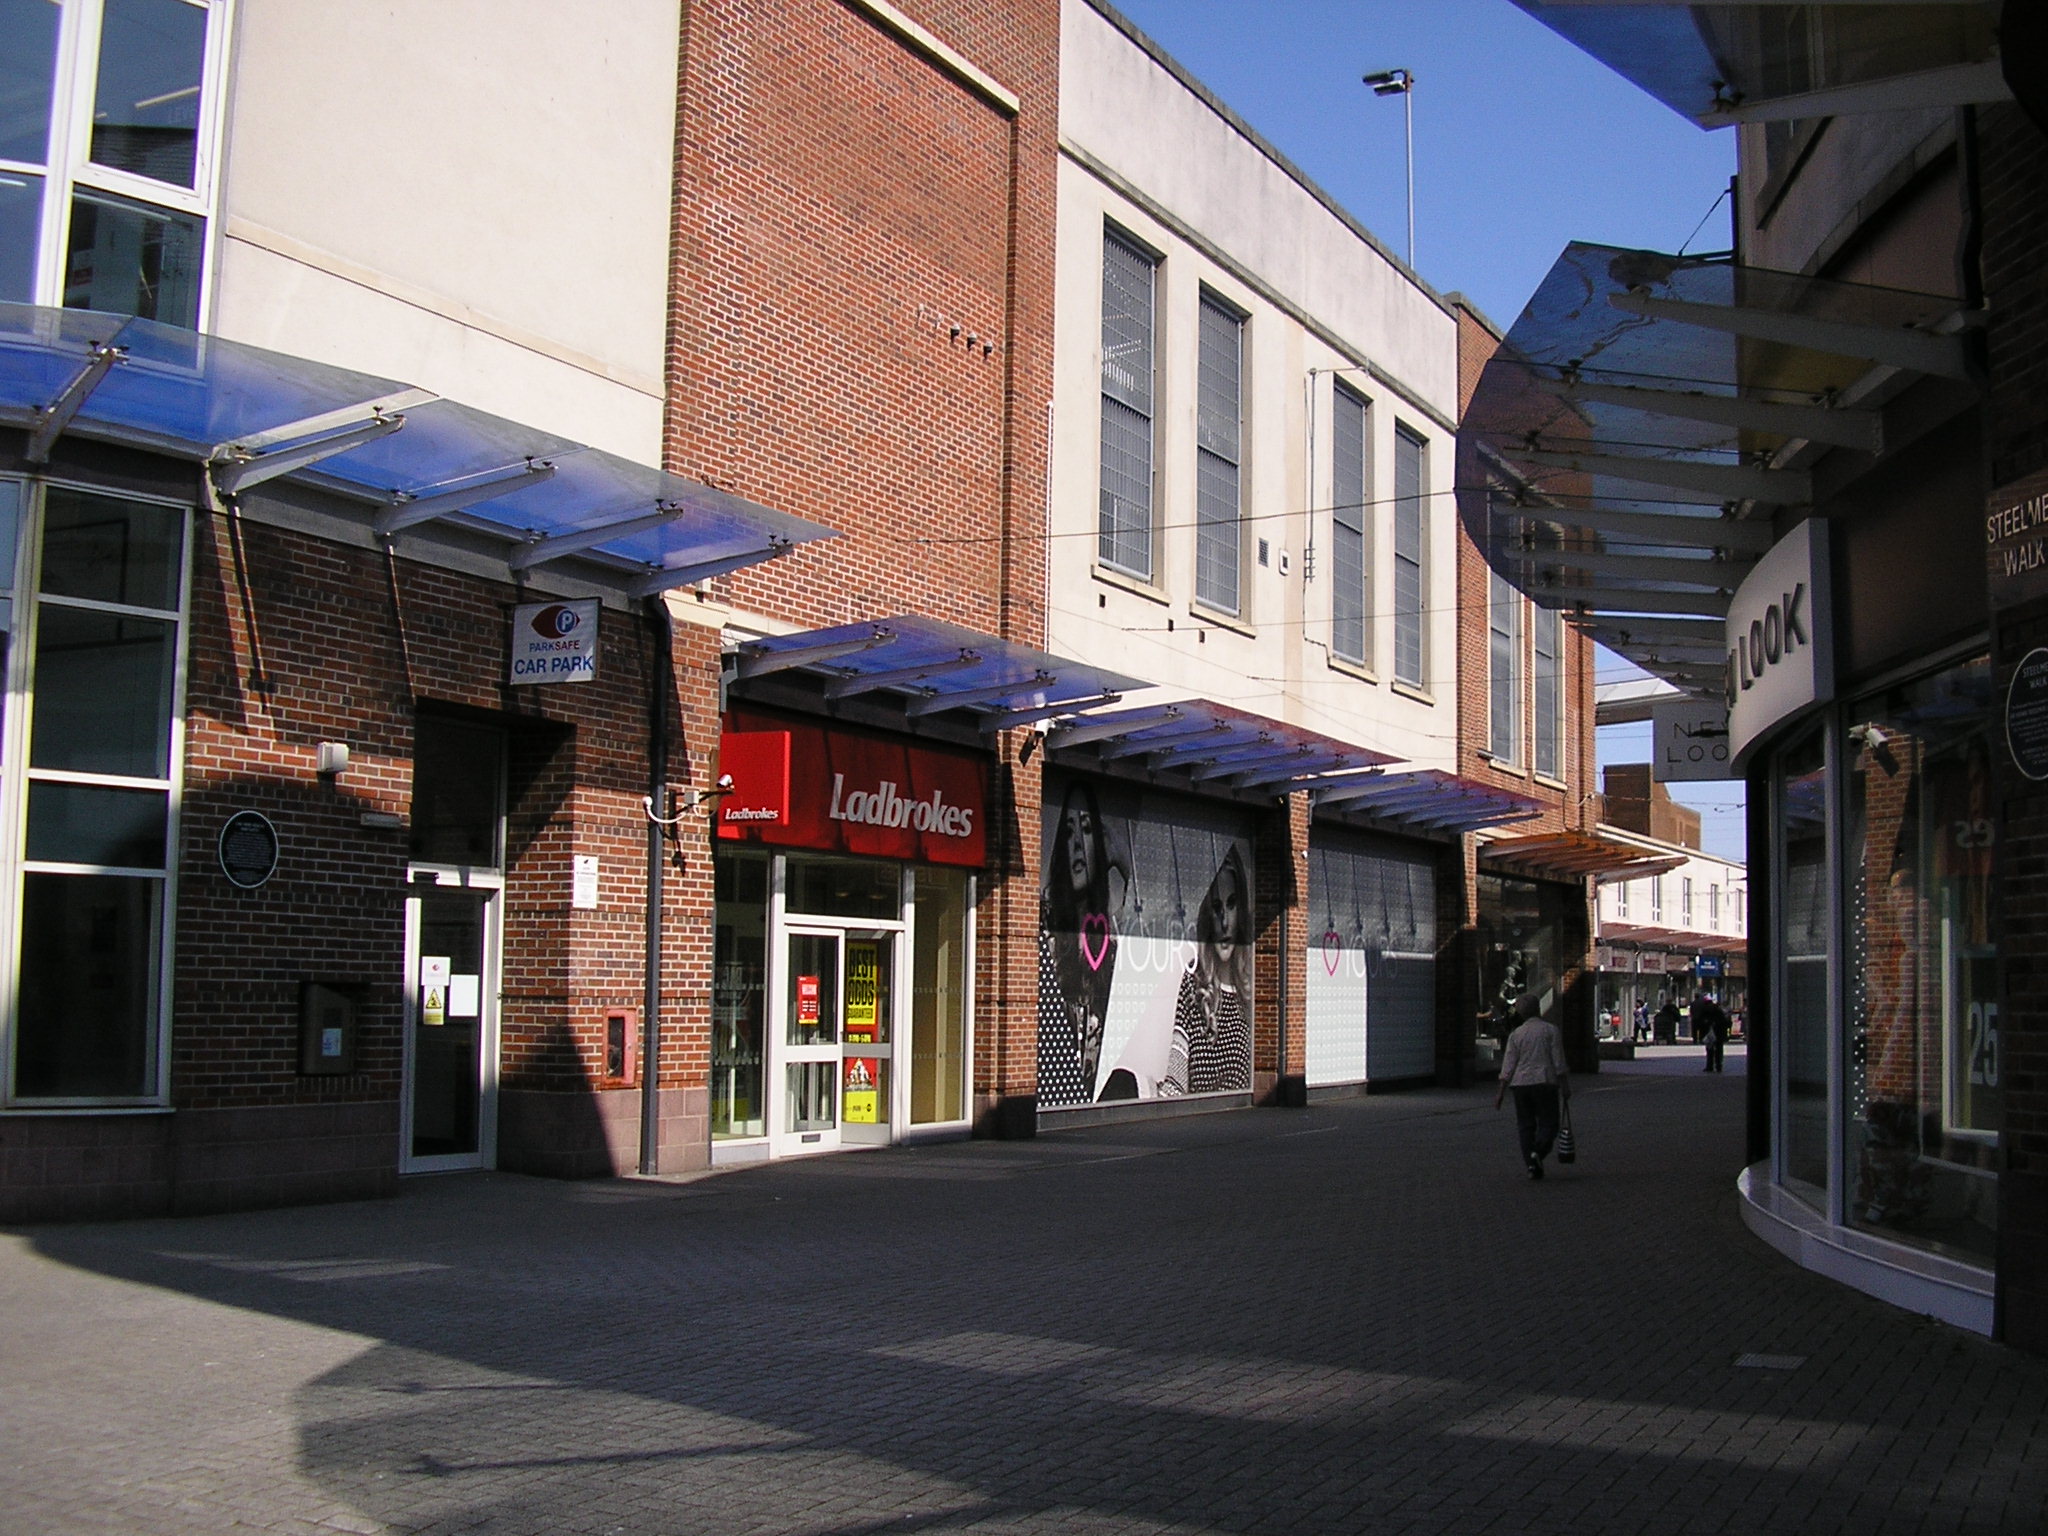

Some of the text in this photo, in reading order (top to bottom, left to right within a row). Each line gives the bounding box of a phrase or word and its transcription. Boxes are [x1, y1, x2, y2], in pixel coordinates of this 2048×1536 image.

[2003, 540, 2046, 577] WALK
[529, 640, 580, 652] PARKSAFE
[1739, 582, 1806, 690] LOOK
[514, 655, 594, 674] CAR PARK
[1674, 721, 1728, 738] NE
[725, 807, 779, 820] Ladbrokes
[829, 772, 974, 838] Ladbrokes
[1112, 915, 1198, 974] YOURS
[849, 949, 875, 978] BEST
[848, 979, 874, 1006] ODDS
[1967, 1001, 1999, 1087] 25
